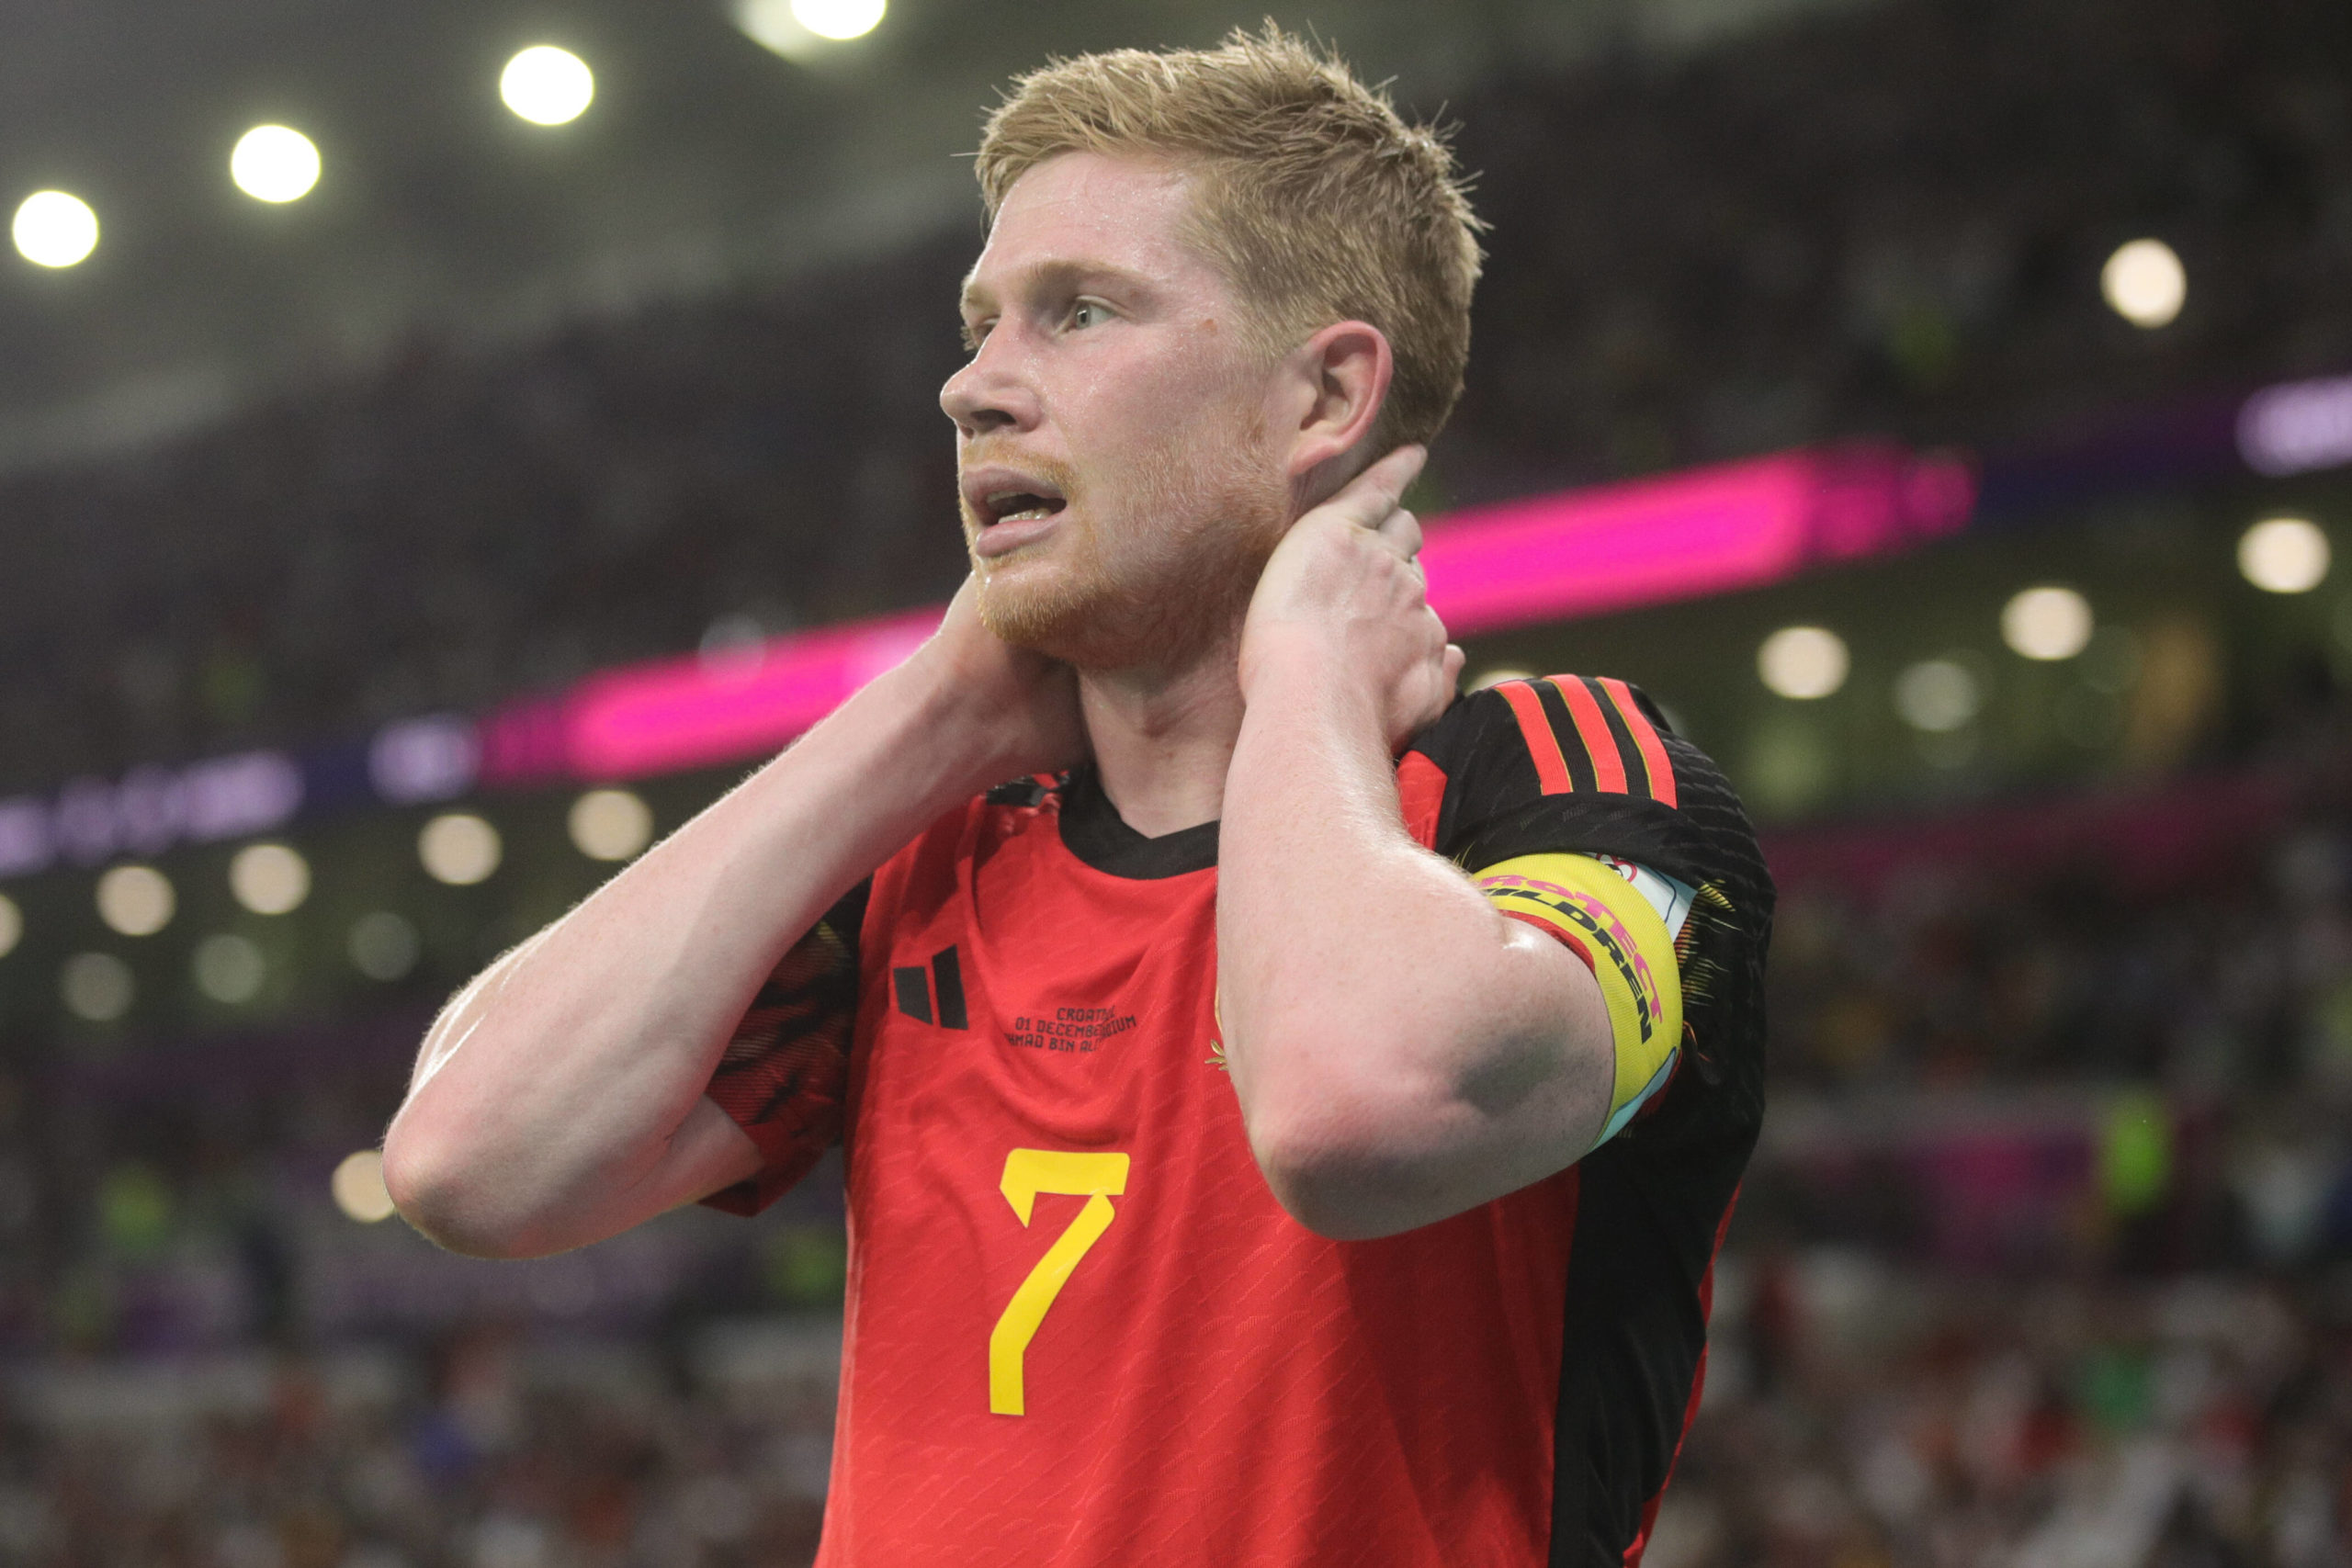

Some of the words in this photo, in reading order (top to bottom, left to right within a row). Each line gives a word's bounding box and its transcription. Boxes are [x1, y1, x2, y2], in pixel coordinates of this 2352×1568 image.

[1480, 874, 1663, 1024] ROTECT
[1480, 887, 1653, 1044] ILDREN
[1015, 1017, 1031, 1032] 01
[1036, 1020, 1104, 1039] DECEMBE
[1048, 1037, 1075, 1053] BIN
[989, 1147, 1131, 1416] 7
